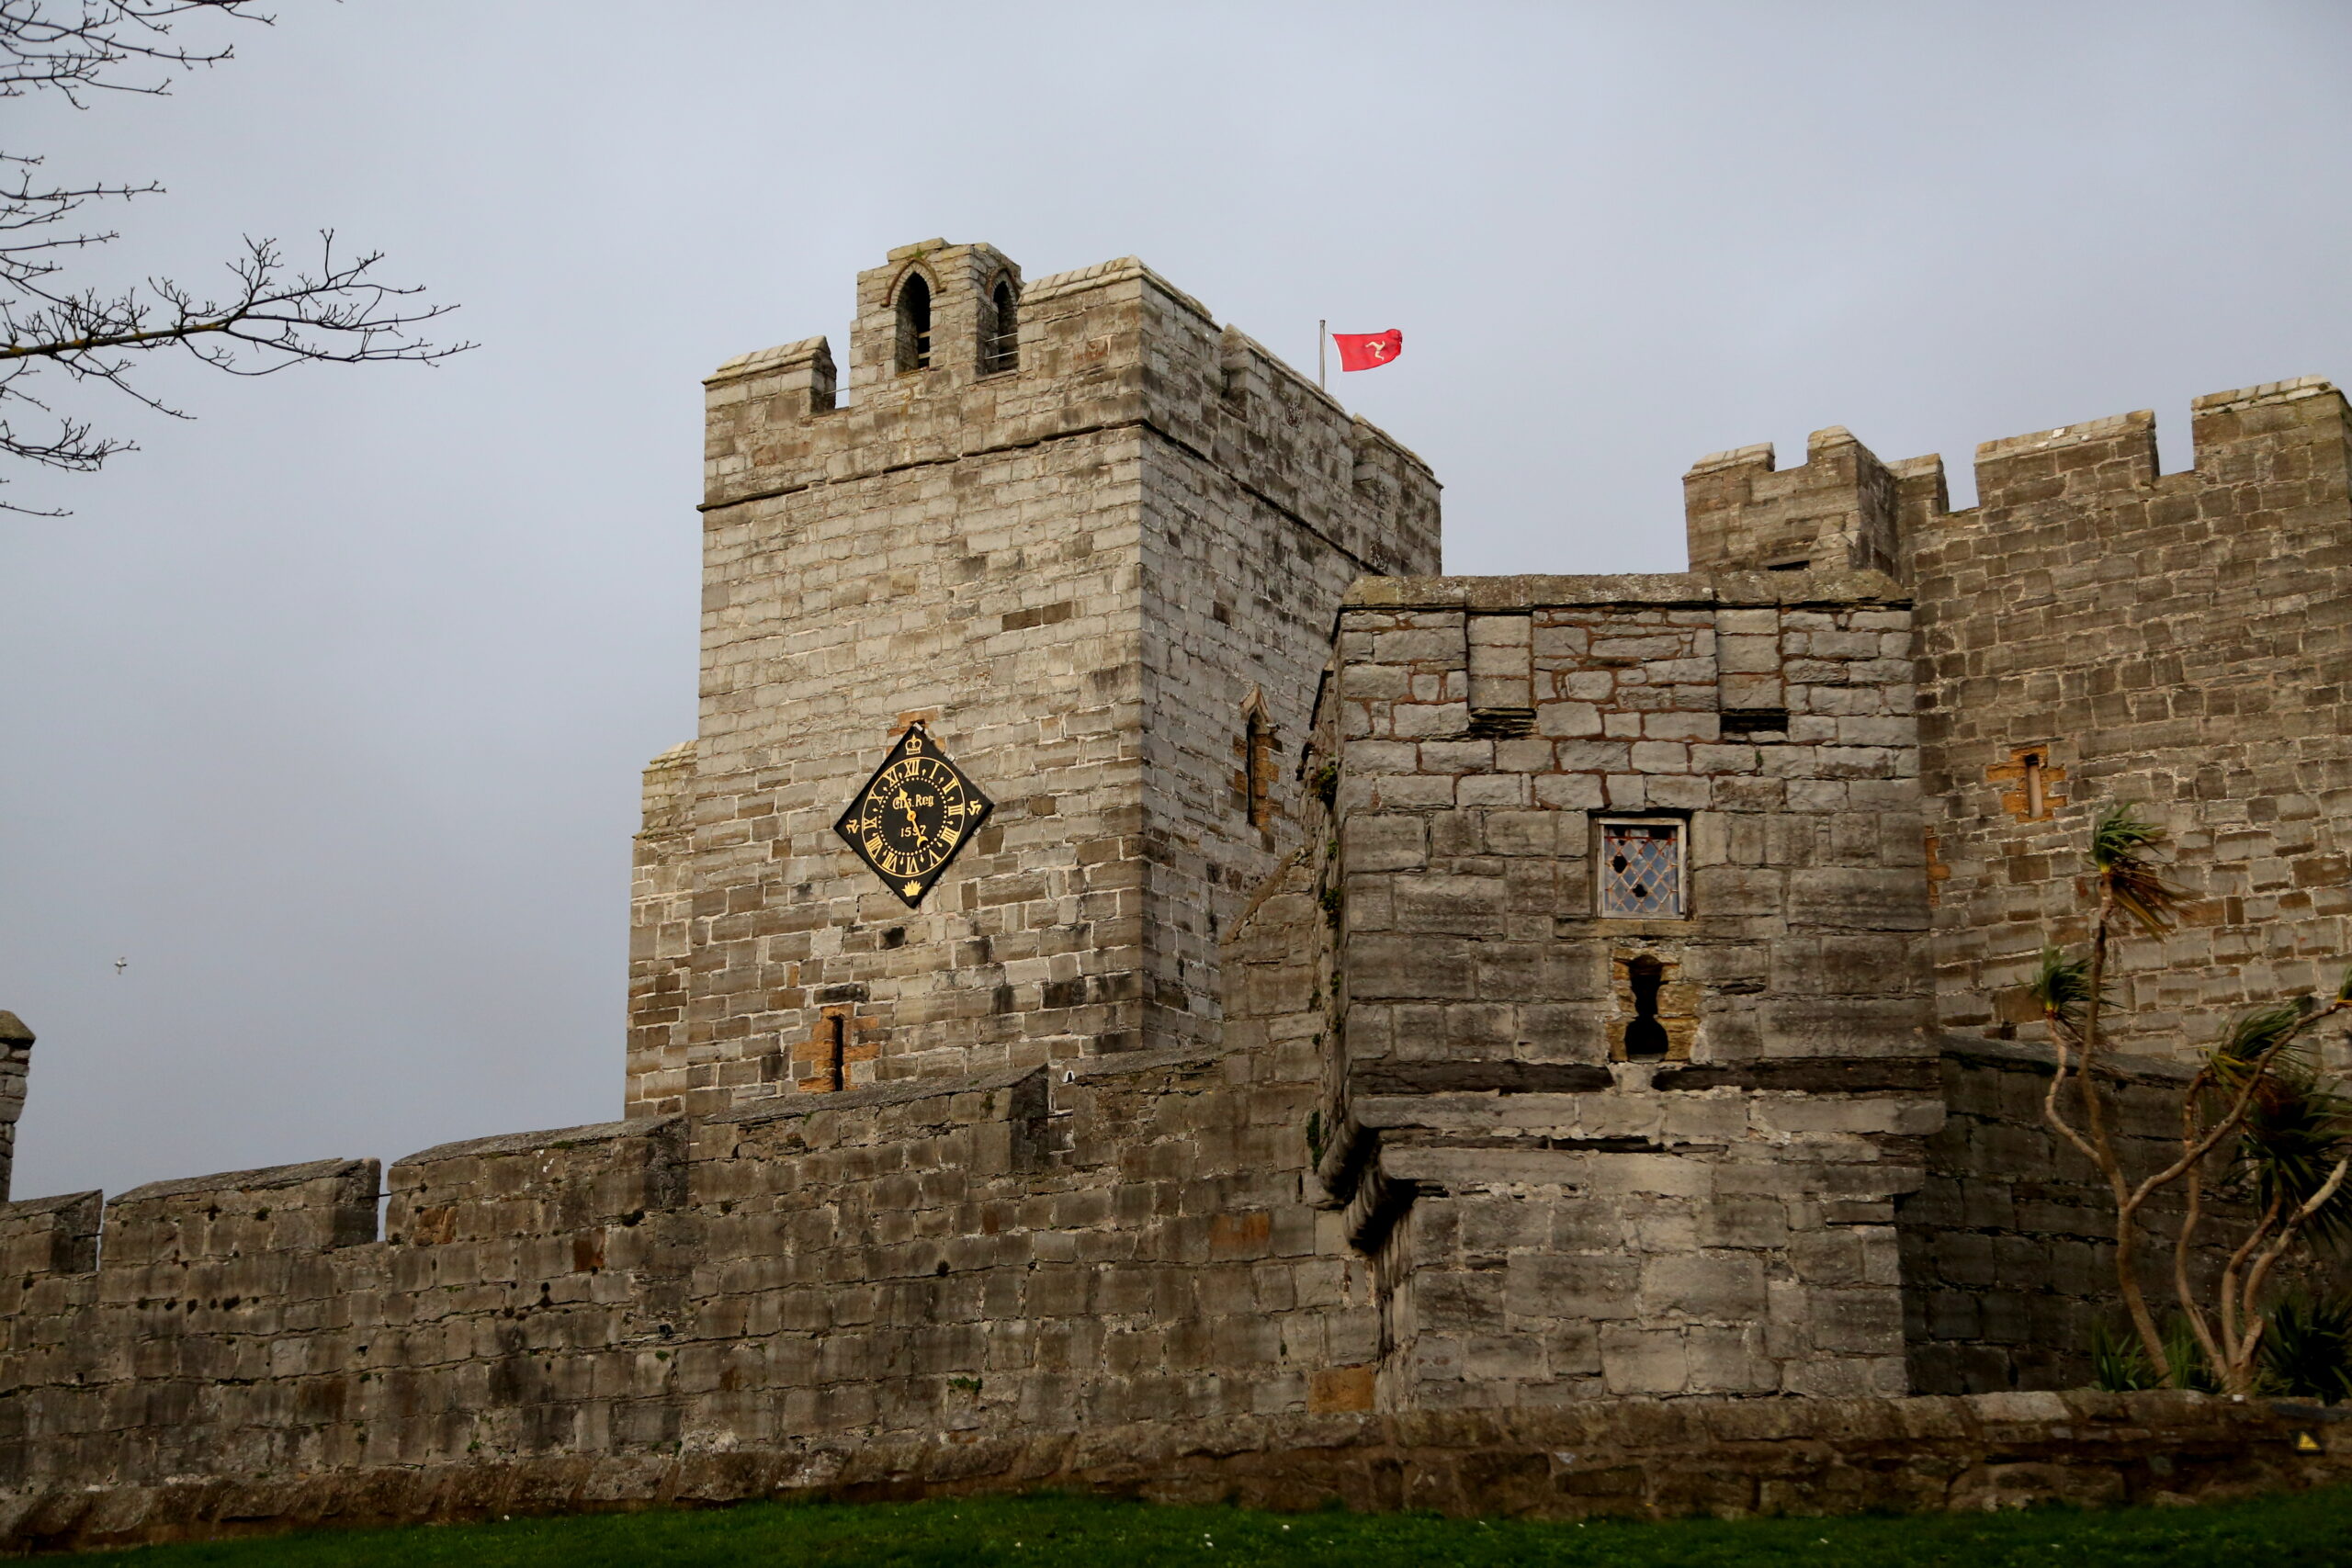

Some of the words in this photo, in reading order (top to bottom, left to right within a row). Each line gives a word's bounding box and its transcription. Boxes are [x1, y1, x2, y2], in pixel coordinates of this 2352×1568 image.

[904, 760, 920, 778] XII
[882, 767, 899, 787] XI
[915, 794, 934, 807] Reg
[947, 803, 964, 817] III
[864, 817, 877, 830] IX
[900, 825, 926, 838] 1597
[905, 856, 920, 874] VI
